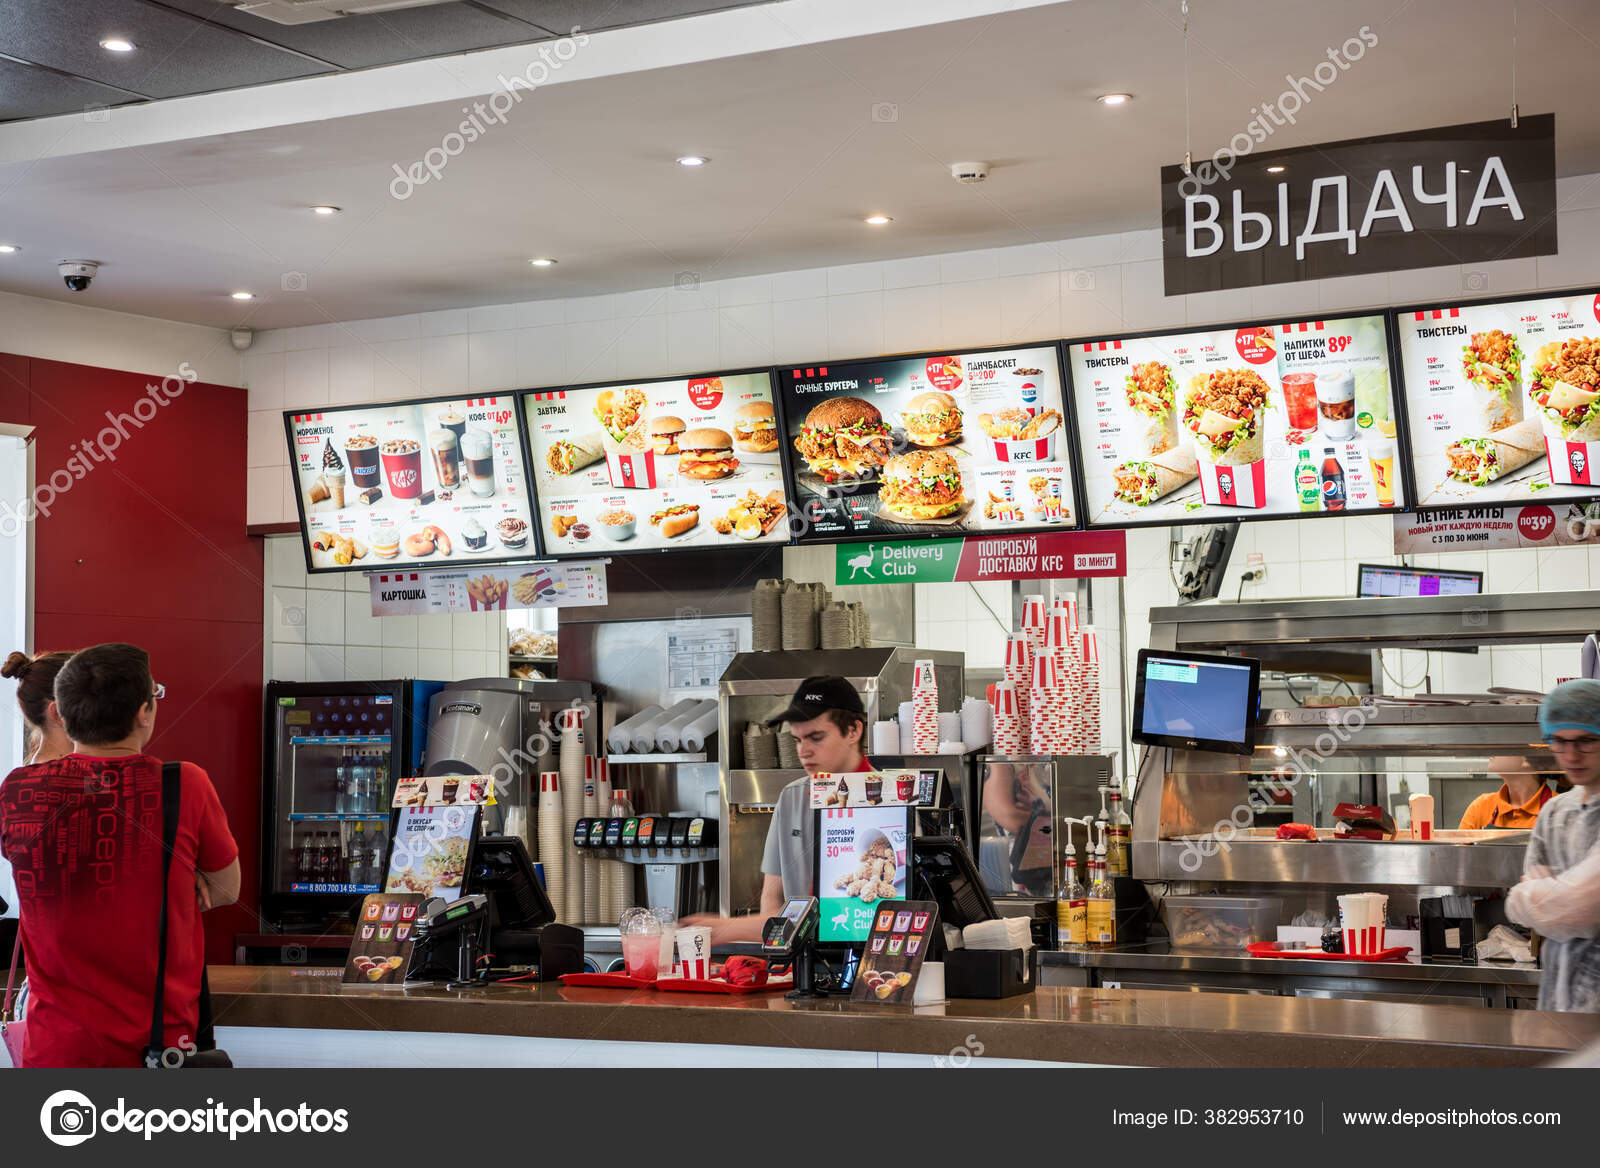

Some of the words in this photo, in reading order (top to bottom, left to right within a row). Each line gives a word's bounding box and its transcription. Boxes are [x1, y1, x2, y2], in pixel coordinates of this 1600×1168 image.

[1185, 156, 1525, 260] ВЫДАЧА
[1417, 325, 1467, 338] ТВИСТЕРЫ
[1284, 338, 1326, 350] НАПИТКИ
[1285, 352, 1296, 361] ОТ
[1299, 349, 1326, 360] ШЕФА
[1085, 356, 1129, 368] ТВИСТЕРЫ
[795, 384, 823, 394] СОЧНЫЕ
[824, 380, 858, 392] БУРГЕРЫ
[469, 412, 486, 421] КОФЕ
[487, 412, 495, 420] ОТ
[537, 406, 566, 416] ЗАВТРАК
[296, 426, 334, 436] МОРОЖЕНОЕ
[1417, 508, 1463, 524] ЛЕТНИЕ
[1468, 507, 1505, 519] ХИТЫ
[1408, 526, 1433, 536] НОВЫЙ
[1434, 524, 1447, 532] ХИТ
[1450, 522, 1482, 532] КАЖДУЮ
[1484, 521, 1513, 530] НЕДЕЛЮ
[1432, 535, 1437, 543] С
[1438, 535, 1443, 543] 3
[1445, 534, 1454, 542] ПО
[1456, 534, 1465, 542] 30
[1467, 533, 1488, 542] ИЮНЯ
[978, 537, 1038, 556] ПОПРОБУЙ
[882, 545, 943, 561] Delivery
[978, 556, 1039, 576] ДОСТАВКУ
[1042, 556, 1063, 571] KFC
[1077, 556, 1087, 567] 30
[1089, 556, 1114, 567] МИНУТ
[882, 562, 917, 576] Club
[381, 589, 426, 601] КАРТОШКА
[18, 788, 97, 807] Design
[827, 827, 855, 835] ПОПРОБУЙ
[827, 836, 854, 844] ДОСТАВКУ
[827, 846, 839, 857] 30
[315, 884, 326, 892] 800
[328, 884, 338, 892] 700
[340, 884, 347, 892] 14
[349, 884, 356, 892] 55
